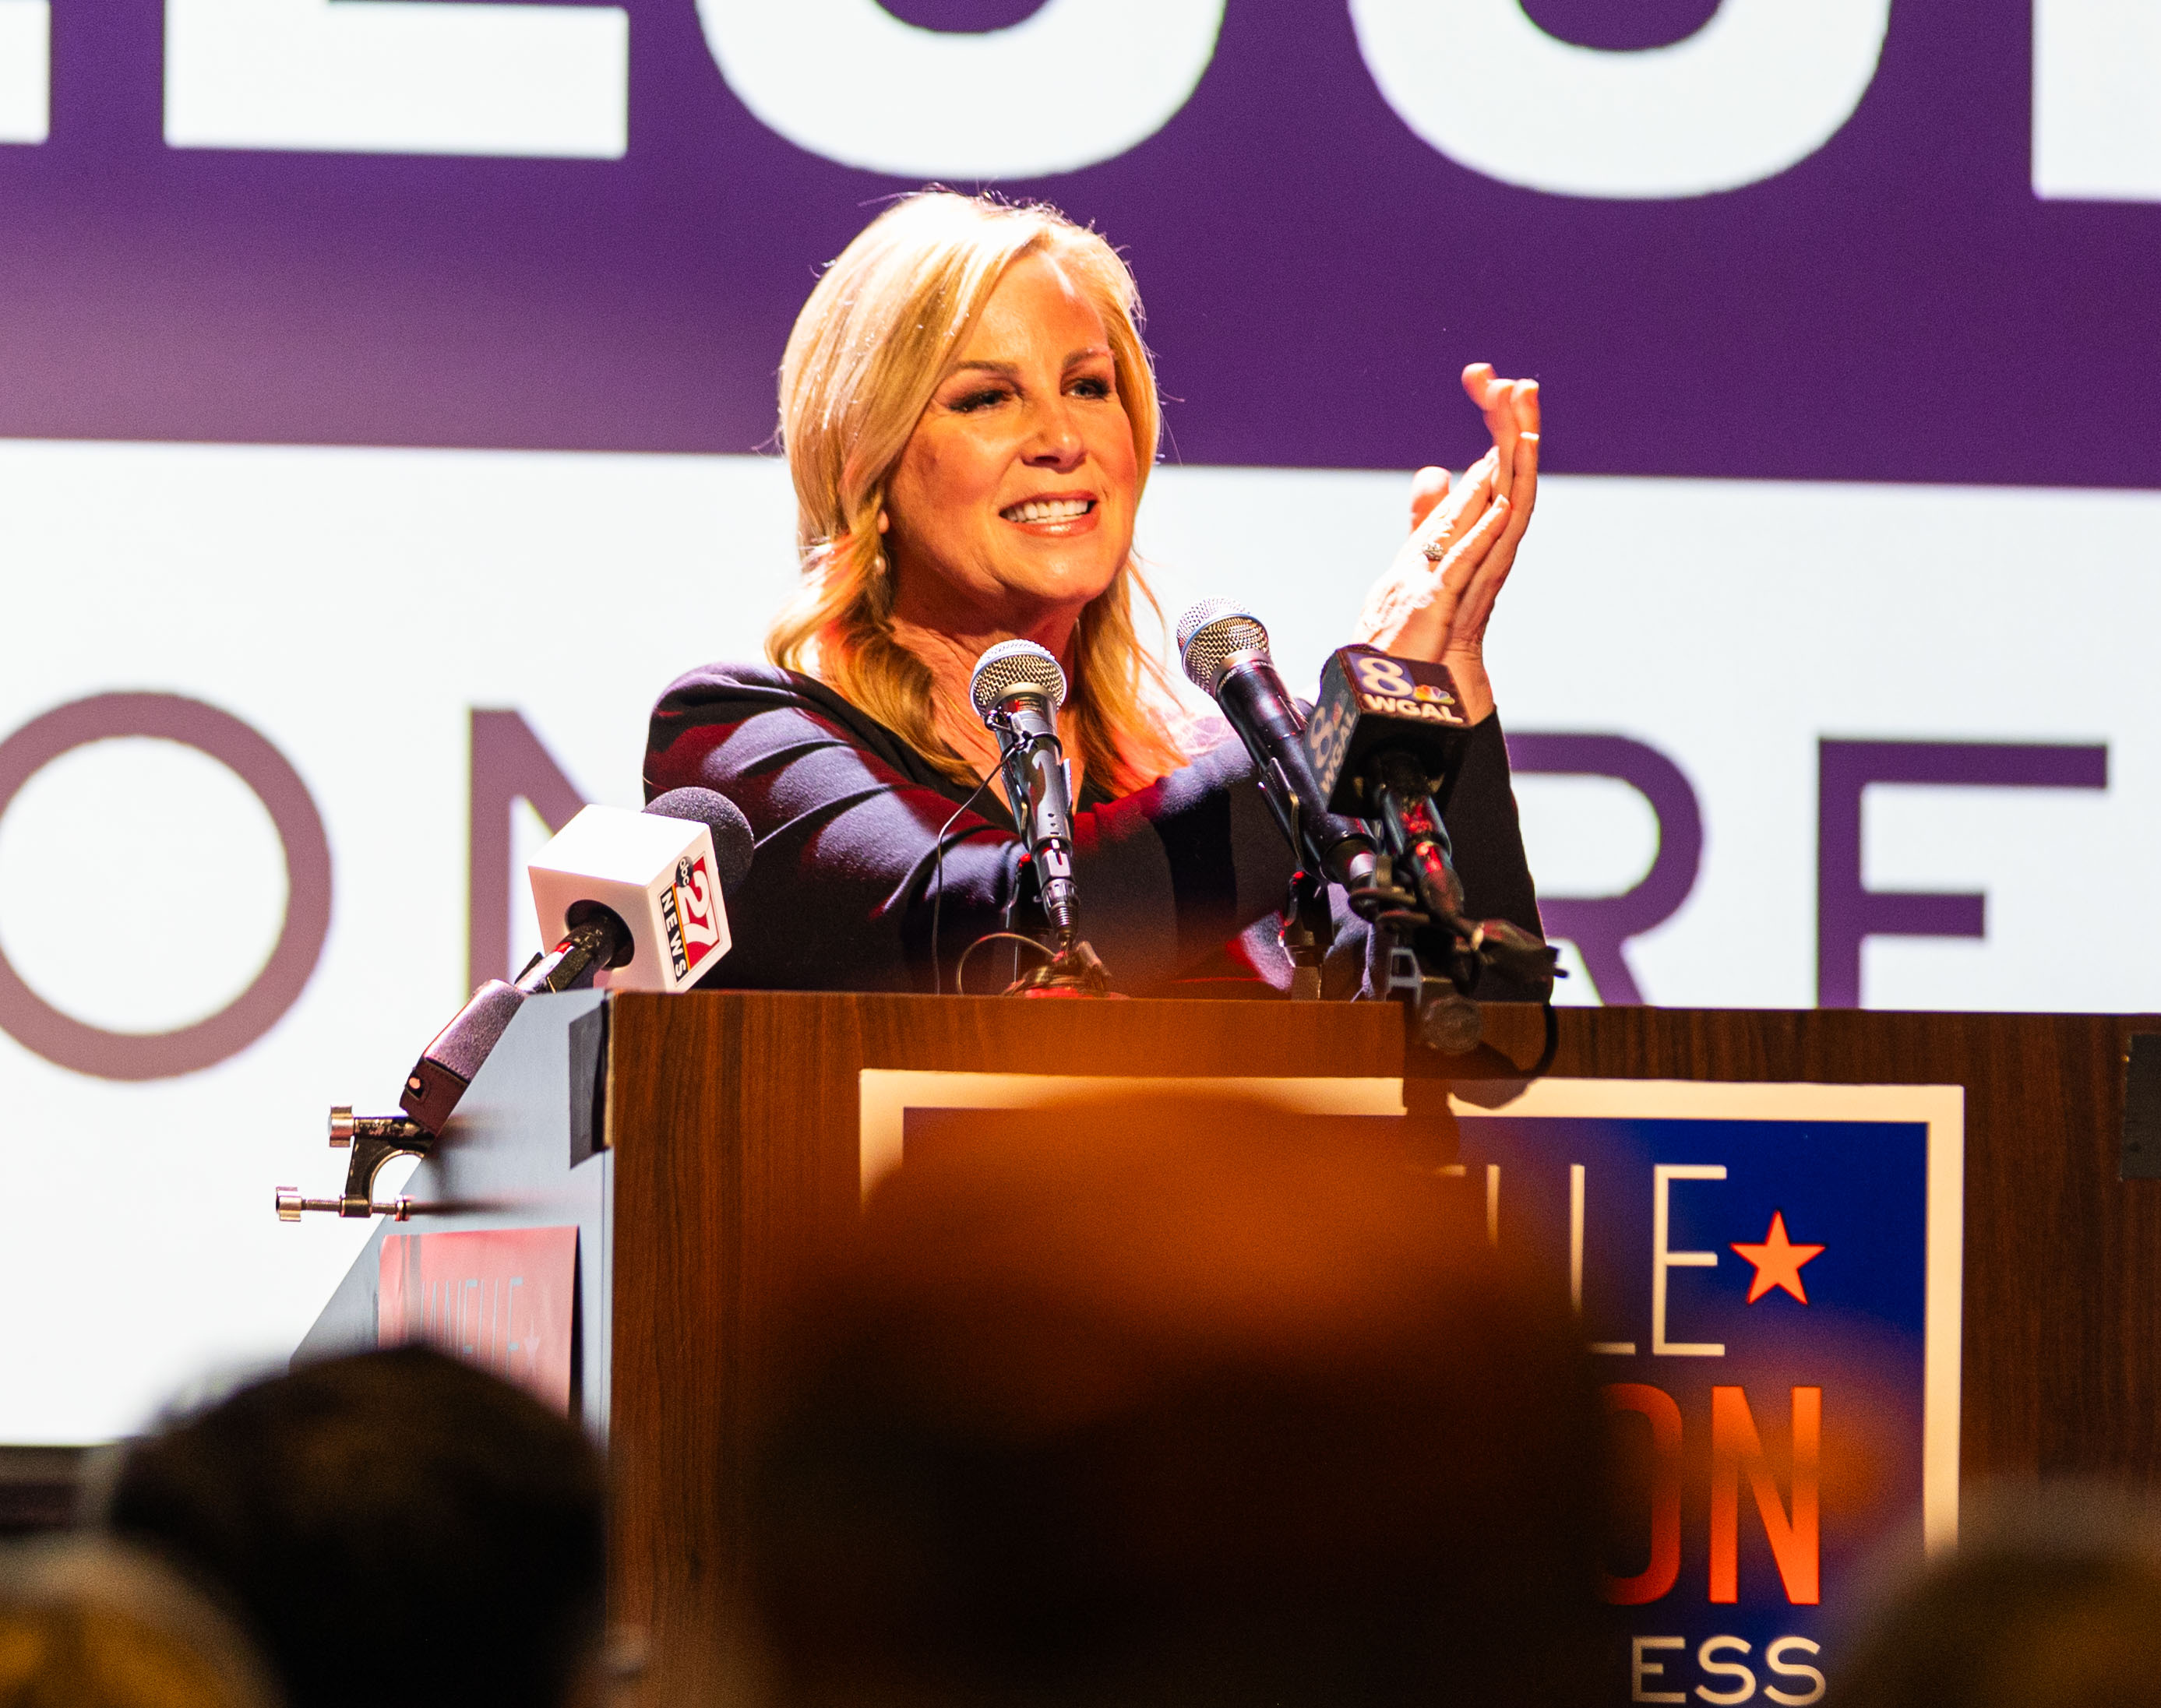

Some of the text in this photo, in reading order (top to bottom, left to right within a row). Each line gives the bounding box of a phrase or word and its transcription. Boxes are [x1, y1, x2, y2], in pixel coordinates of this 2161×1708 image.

[1358, 657, 1413, 697] 8
[1363, 693, 1464, 724] WGAL
[1310, 706, 1334, 769] 8
[1320, 710, 1357, 794] WGAL
[679, 858, 690, 887] abc
[661, 890, 686, 977] NEWS
[675, 869, 719, 948] 27
[1630, 1635, 1828, 1706] ESS
